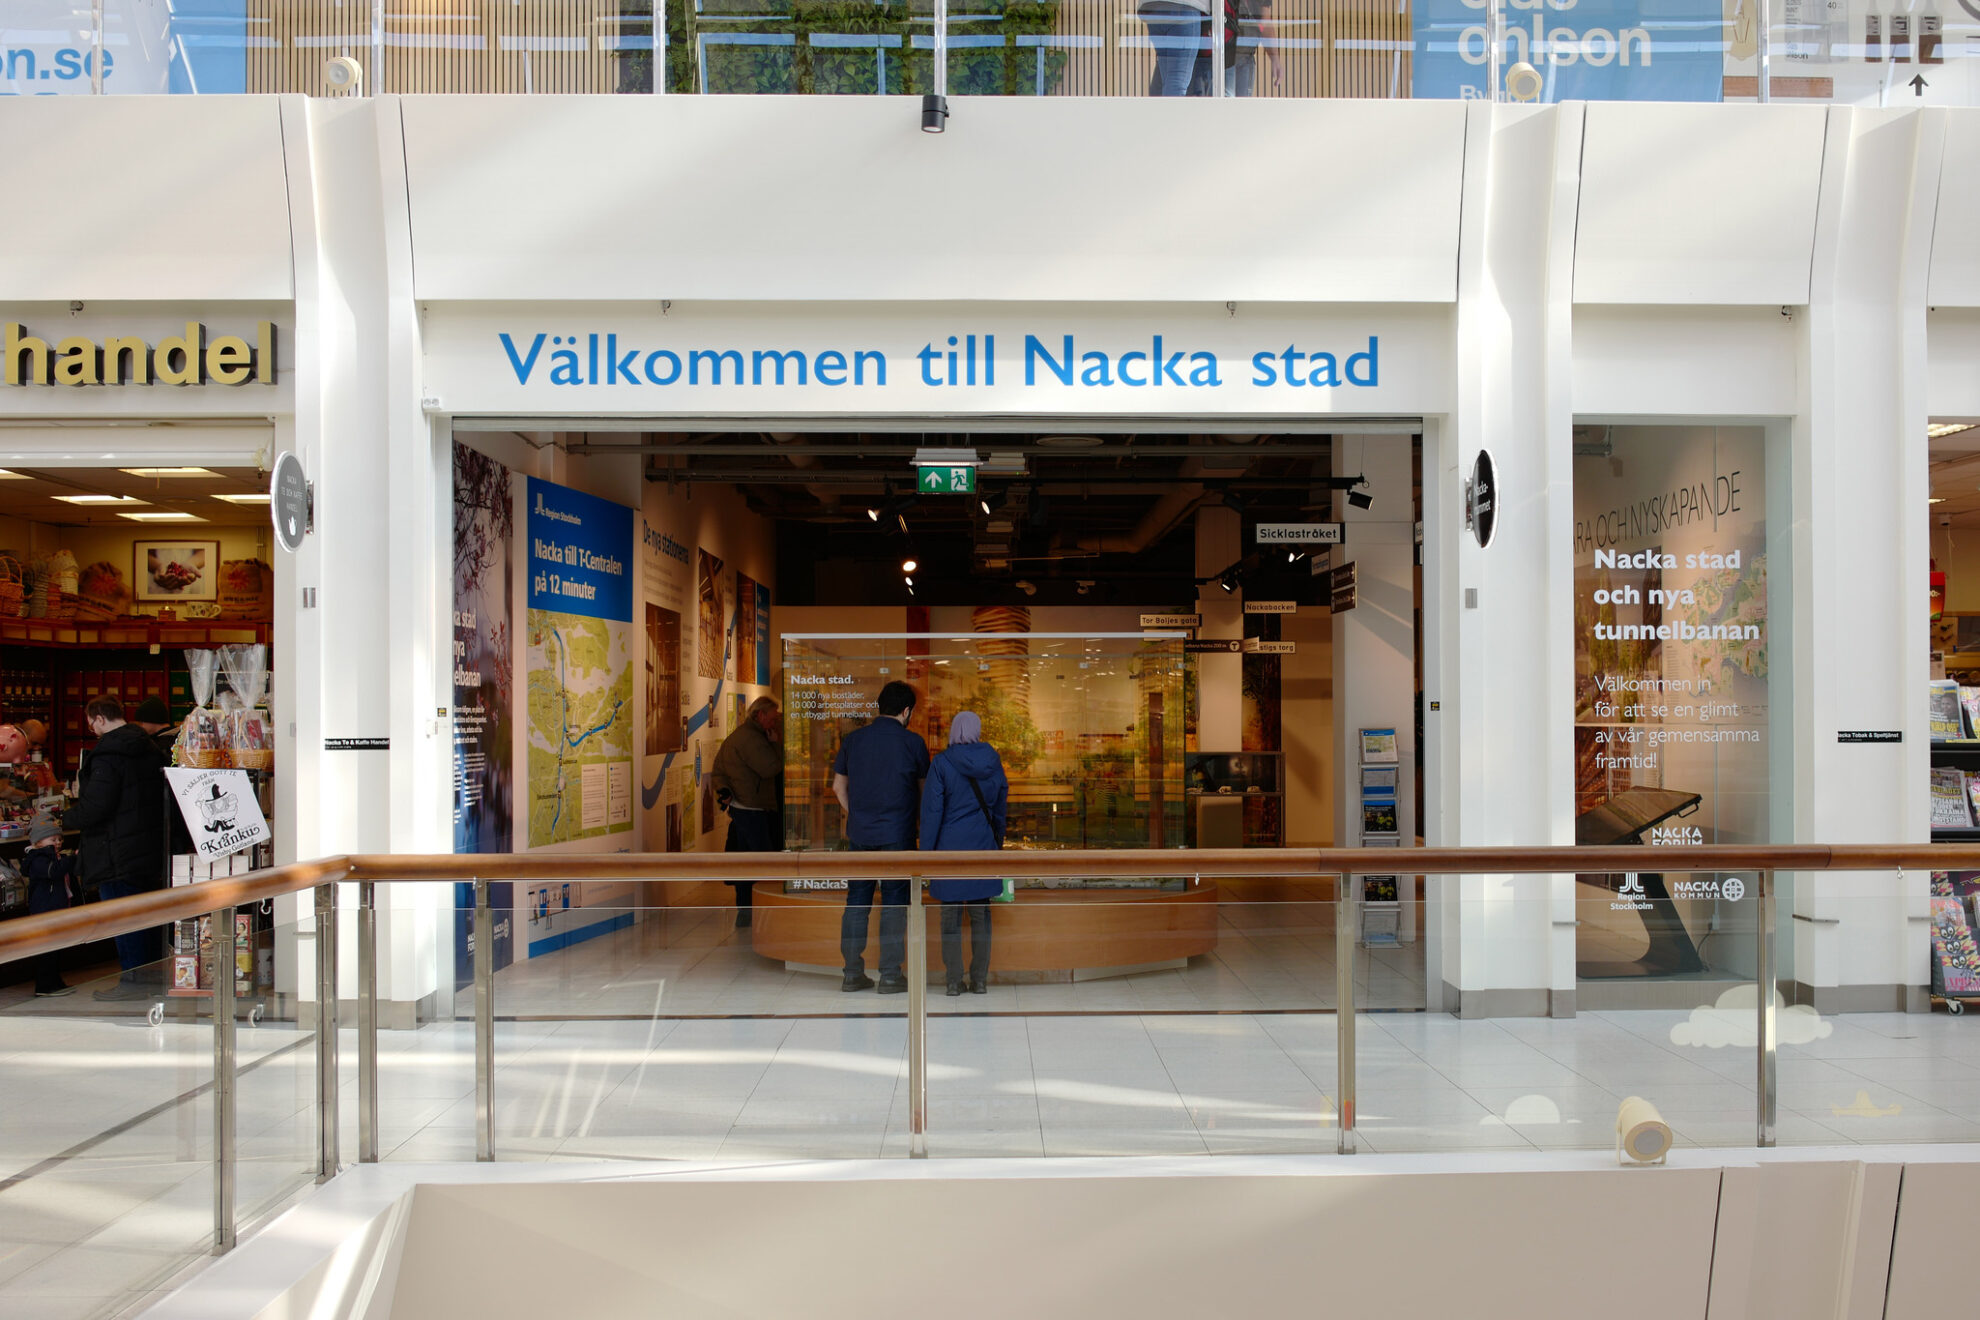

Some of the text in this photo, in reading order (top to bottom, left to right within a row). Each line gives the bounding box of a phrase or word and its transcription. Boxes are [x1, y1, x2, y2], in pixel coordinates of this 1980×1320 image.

[1457, 13, 1651, 67] ohlson
[5, 321, 278, 388] handel
[498, 333, 1379, 387] Välkommen till Nacka stad
[1573, 471, 1740, 554] RA OCH NYSKAPANDE
[1259, 527, 1337, 540] Sicklastråket
[535, 537, 623, 577] Nacka till T-Centralen
[1594, 548, 1742, 570] Nacka stad
[535, 569, 597, 601] på 12 minuter
[1593, 584, 1696, 611] och nya
[1246, 603, 1295, 612] Nackabacken
[1142, 616, 1153, 625] Tor
[1593, 619, 1760, 641] tunnelbanan
[1278, 644, 1294, 654] torg
[790, 673, 855, 686] Nacka stad.
[1594, 675, 1712, 692] Välkommen in
[791, 691, 799, 700] 14
[801, 691, 817, 700] 000
[791, 700, 800, 709] 10
[801, 700, 817, 709] 000
[1594, 701, 1740, 722] för att se en glimt
[1595, 727, 1760, 748] av vår gemensamma
[1594, 752, 1658, 770] framtid!
[1652, 826, 1703, 839] NACKA
[1674, 881, 1720, 892] NACKA
[1617, 892, 1647, 902] Region
[1610, 902, 1654, 911] Stockholm
